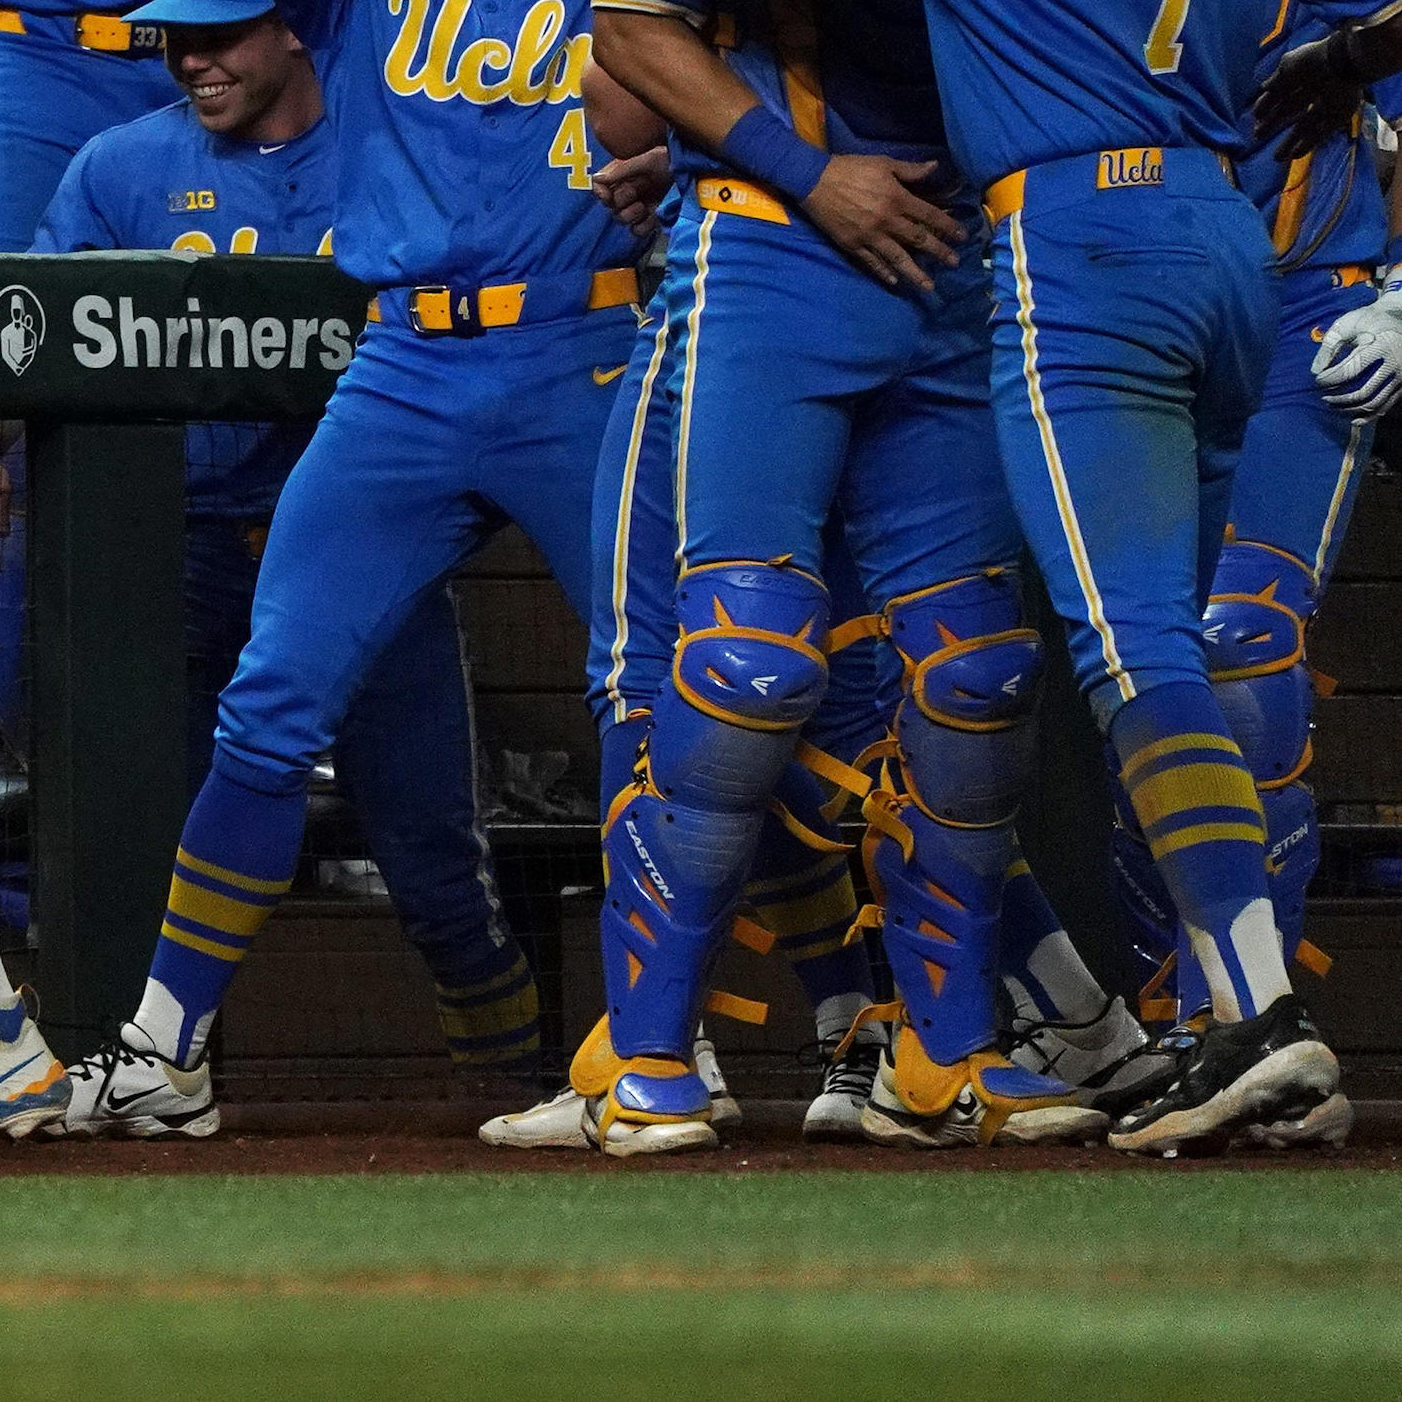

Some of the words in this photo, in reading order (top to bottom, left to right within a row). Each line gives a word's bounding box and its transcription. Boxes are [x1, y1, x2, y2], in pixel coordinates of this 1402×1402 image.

[548, 108, 593, 190] 4
[1101, 150, 1163, 185] Ucla
[72, 294, 353, 371] Shriners
[625, 820, 675, 900] EASTON
[1269, 824, 1308, 860] STON
